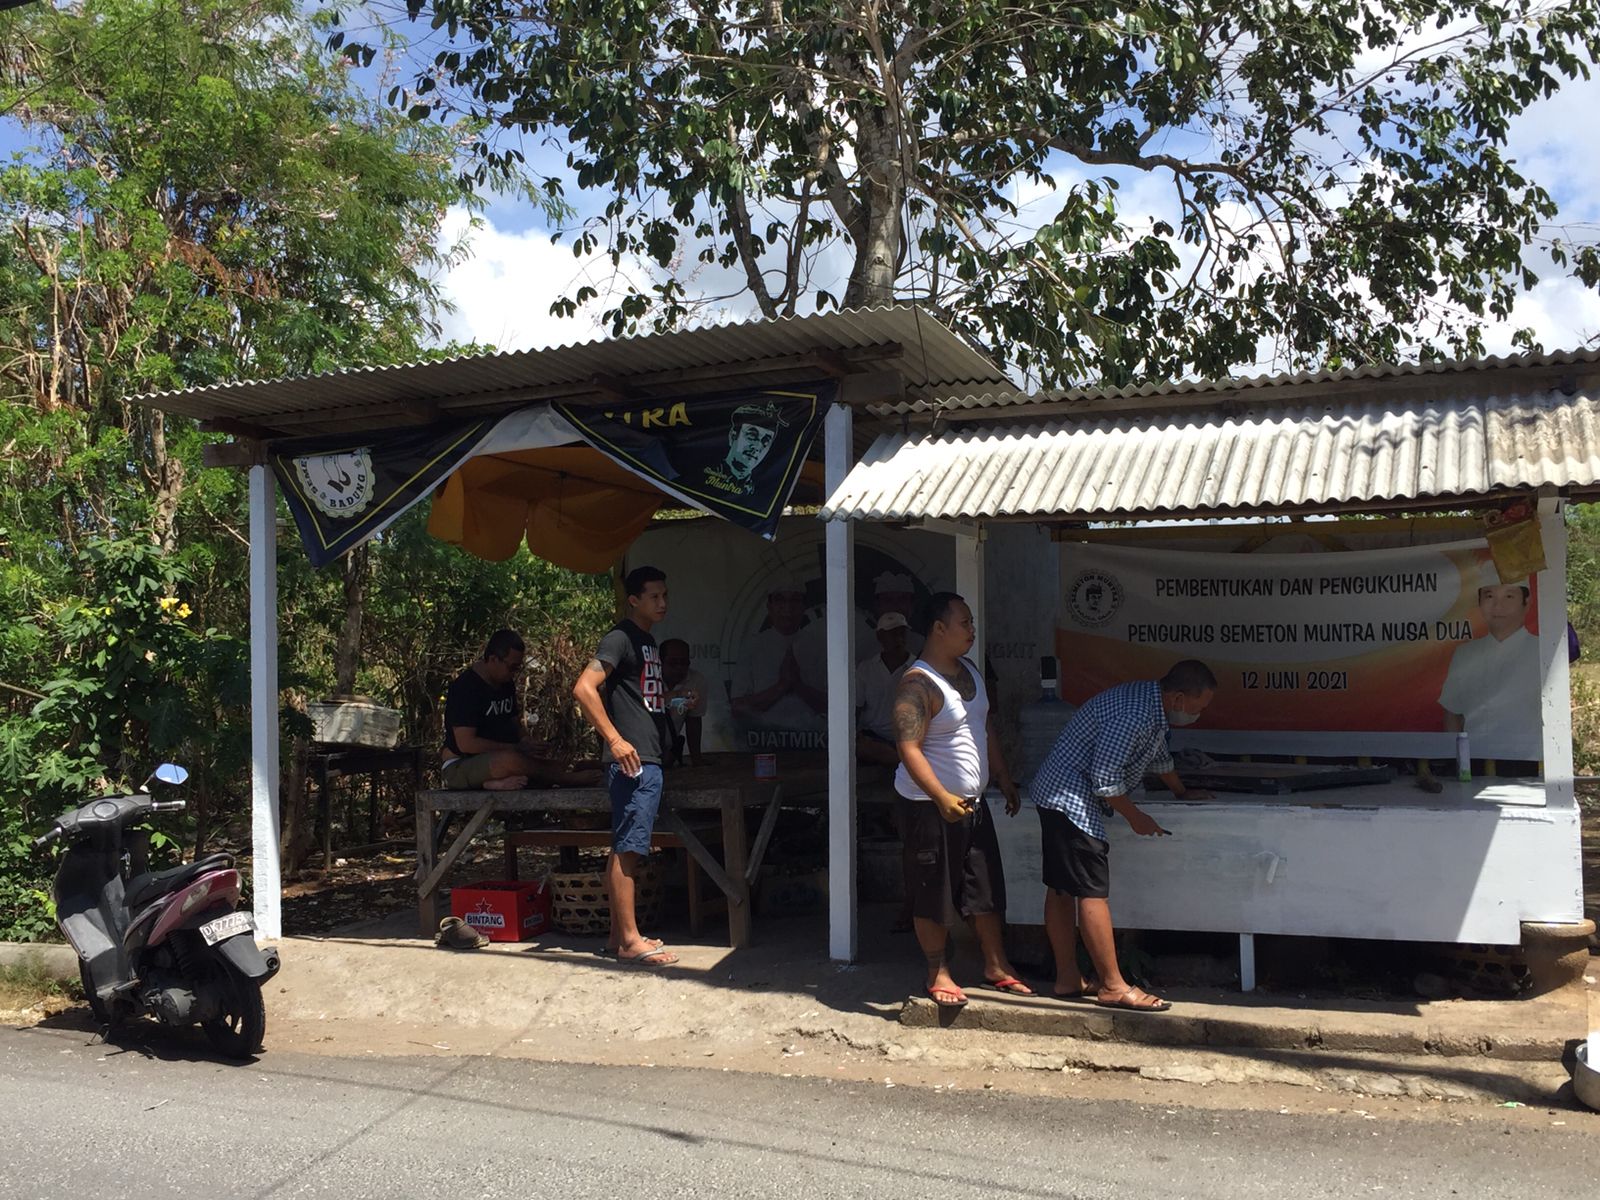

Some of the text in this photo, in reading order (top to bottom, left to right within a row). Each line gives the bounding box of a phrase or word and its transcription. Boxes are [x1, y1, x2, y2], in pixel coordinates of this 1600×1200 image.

[329, 474, 366, 508] BADUNG
[1156, 573, 1437, 597] PEMBENTUKAN DAN PENGUKUHAN
[1128, 620, 1473, 643] PENGURUS SEMETON MUNTRA NUSA DUA
[1242, 671, 1348, 690] 12 JUNI 2021
[747, 730, 827, 749] DIATMIK
[466, 914, 504, 926] BINTANG
